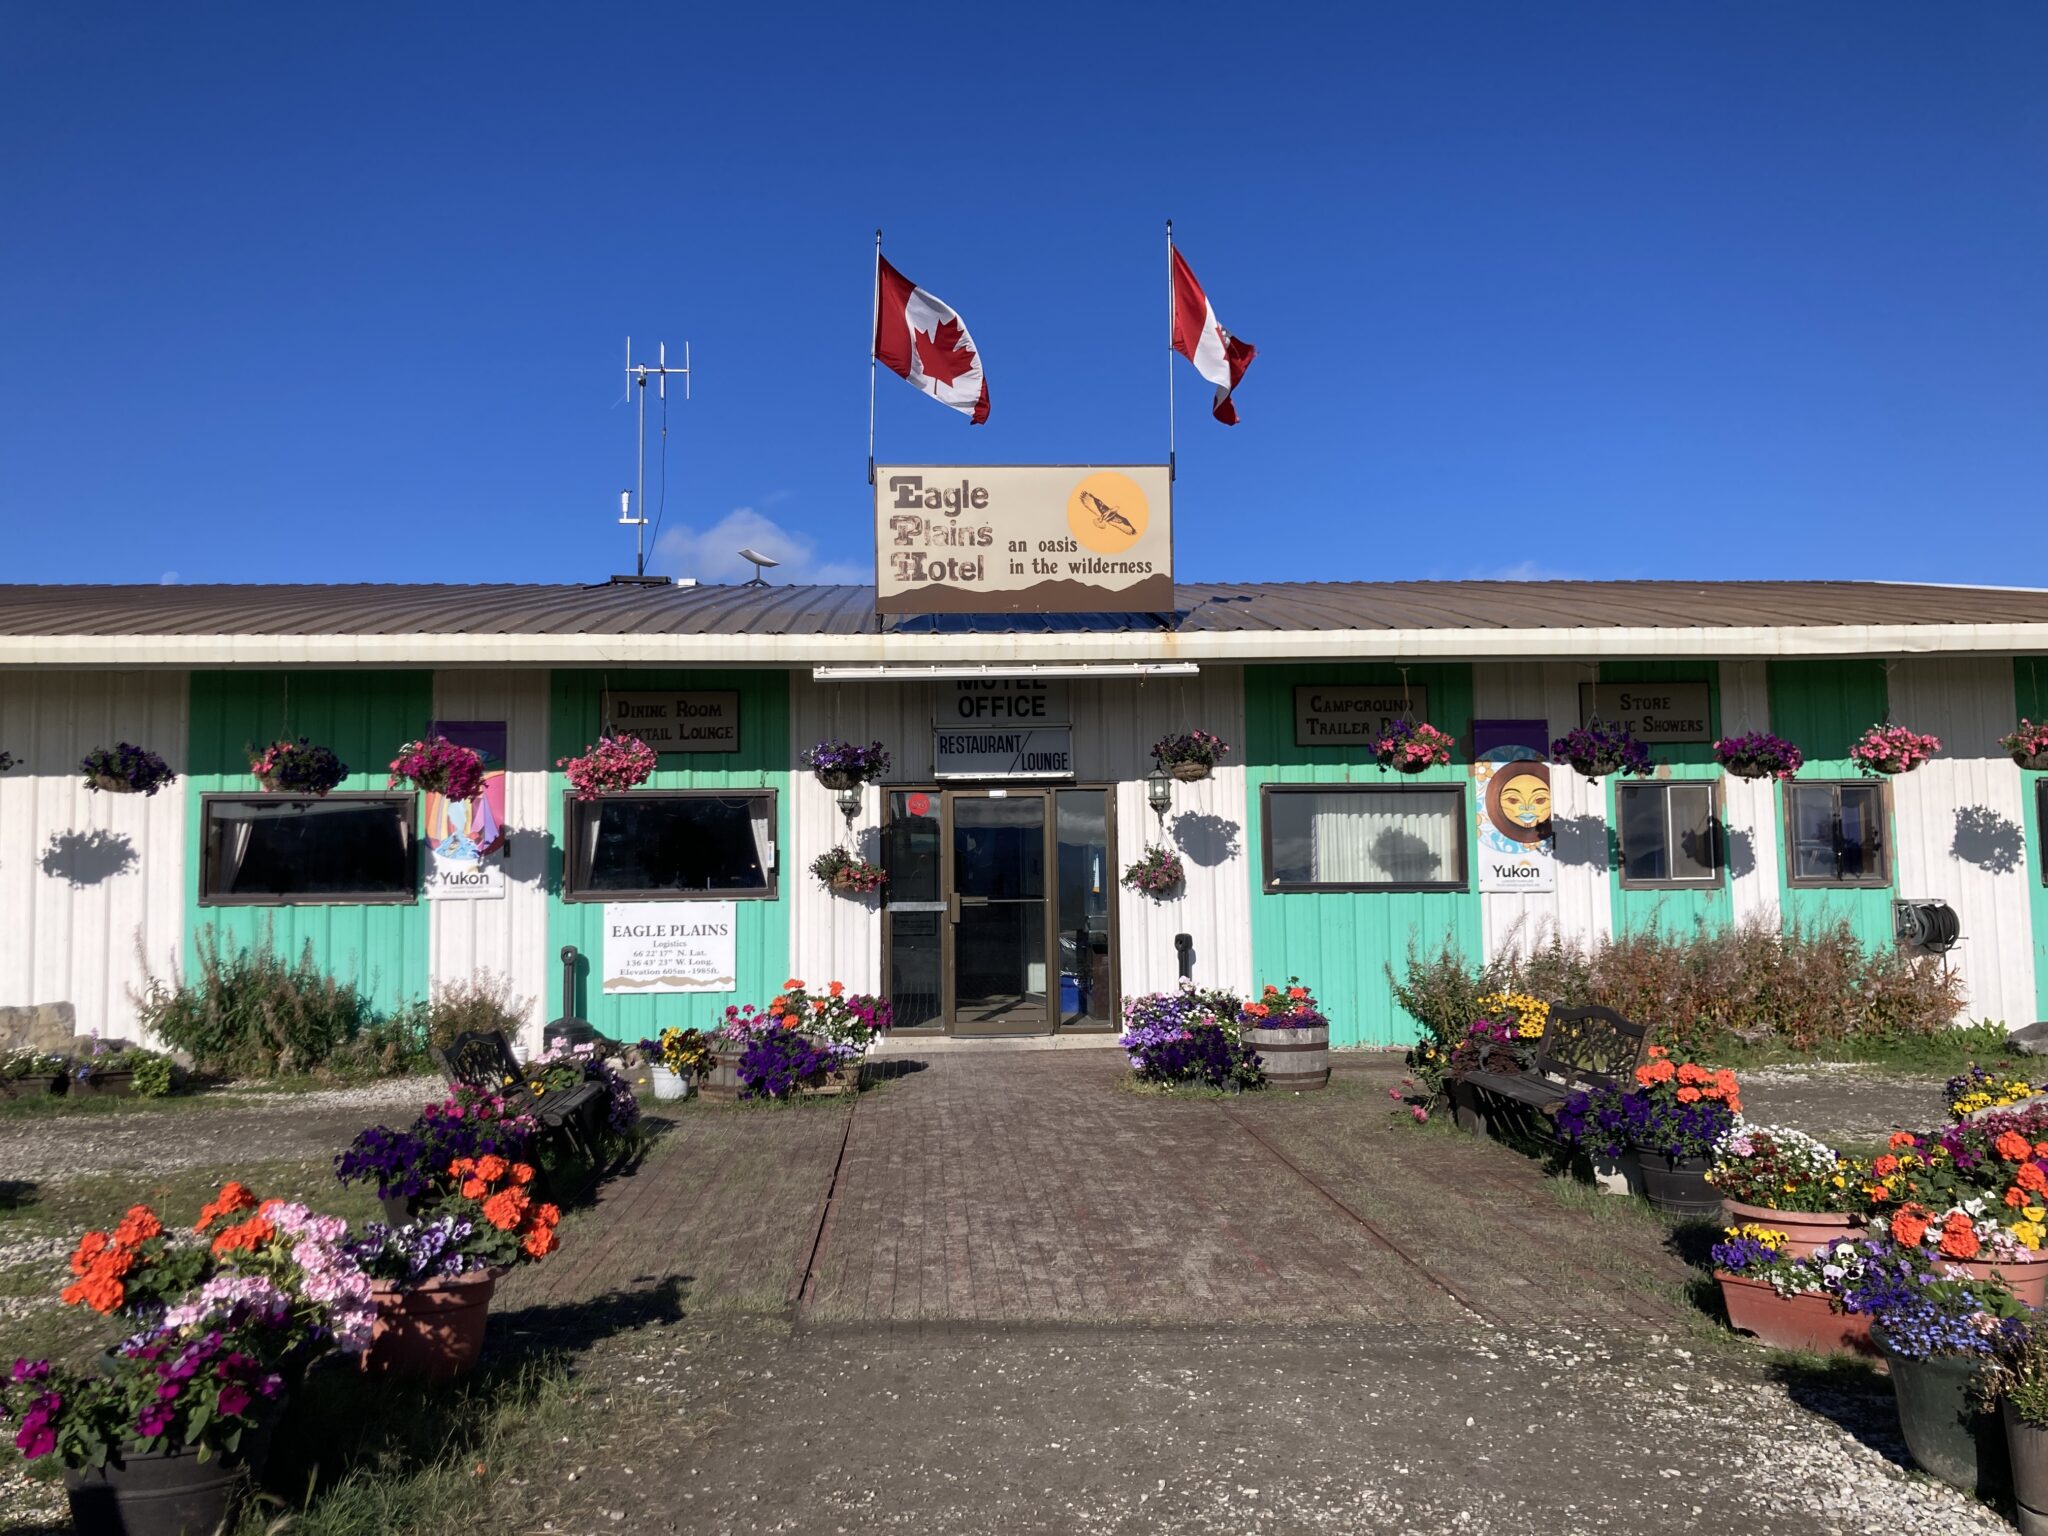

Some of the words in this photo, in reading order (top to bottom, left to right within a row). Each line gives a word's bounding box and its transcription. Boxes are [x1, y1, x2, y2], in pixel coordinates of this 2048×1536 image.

[889, 475, 989, 517] Eagle
[889, 514, 993, 547] Plains
[1008, 539, 1027, 552] an
[1038, 536, 1078, 552] oasis
[890, 552, 985, 581] Hotel
[1009, 558, 1024, 574] in
[1032, 558, 1058, 574] the
[1069, 557, 1152, 574] wilderness
[617, 700, 667, 718] DINING
[675, 700, 722, 718] ROOM
[958, 695, 1046, 718] OFFICE
[1310, 695, 1414, 713] CAMPGROUND
[1620, 693, 1671, 711] STORE
[679, 723, 734, 740] LOUNGE
[1306, 718, 1370, 735] TRAILER
[1643, 715, 1703, 733] SHOWERS
[939, 735, 1021, 754] RESTAURANT
[1021, 752, 1068, 771] LOUNGE
[440, 872, 489, 886] Yukon
[1492, 864, 1540, 878] Yukon
[612, 925, 666, 938] EAGLE
[670, 923, 728, 937] PLAINS
[653, 940, 687, 949] Logistics
[690, 949, 707, 957] Lat.
[689, 959, 713, 967] Long.
[620, 968, 660, 976] Elevation
